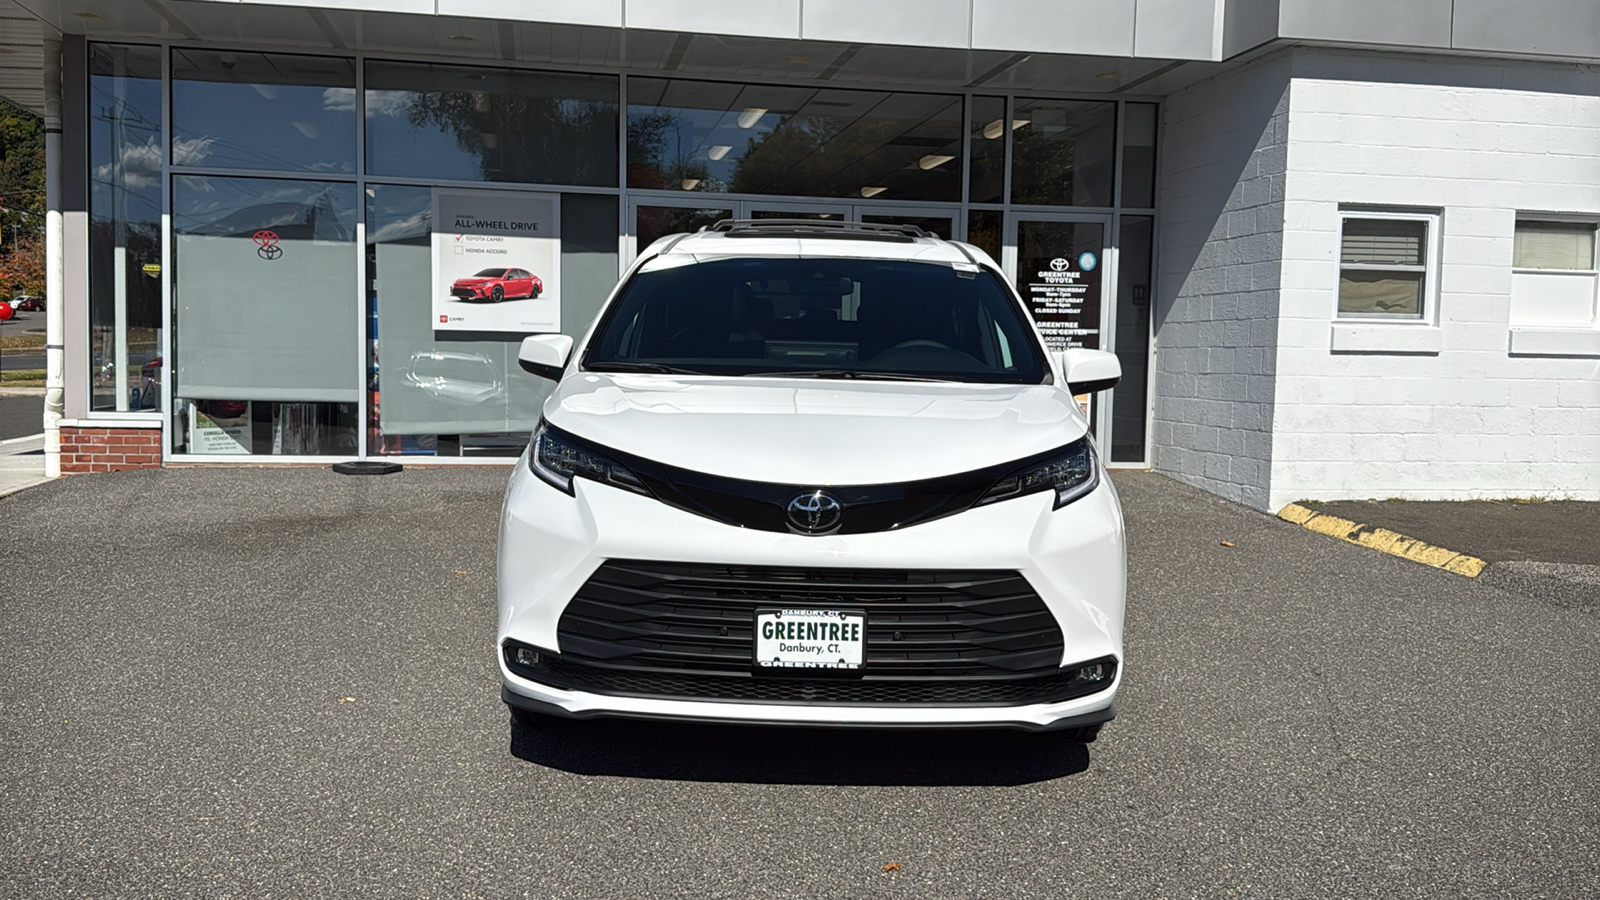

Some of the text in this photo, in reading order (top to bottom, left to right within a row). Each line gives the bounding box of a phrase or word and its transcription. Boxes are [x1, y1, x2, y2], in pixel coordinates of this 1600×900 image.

[454, 219, 539, 231] ALL-WHEEL DRIVE
[781, 609, 826, 618] DANBURY,
[762, 620, 860, 642] GREENTREE
[779, 642, 841, 656] Danbury, CT.
[760, 660, 860, 669] GREENTREE
